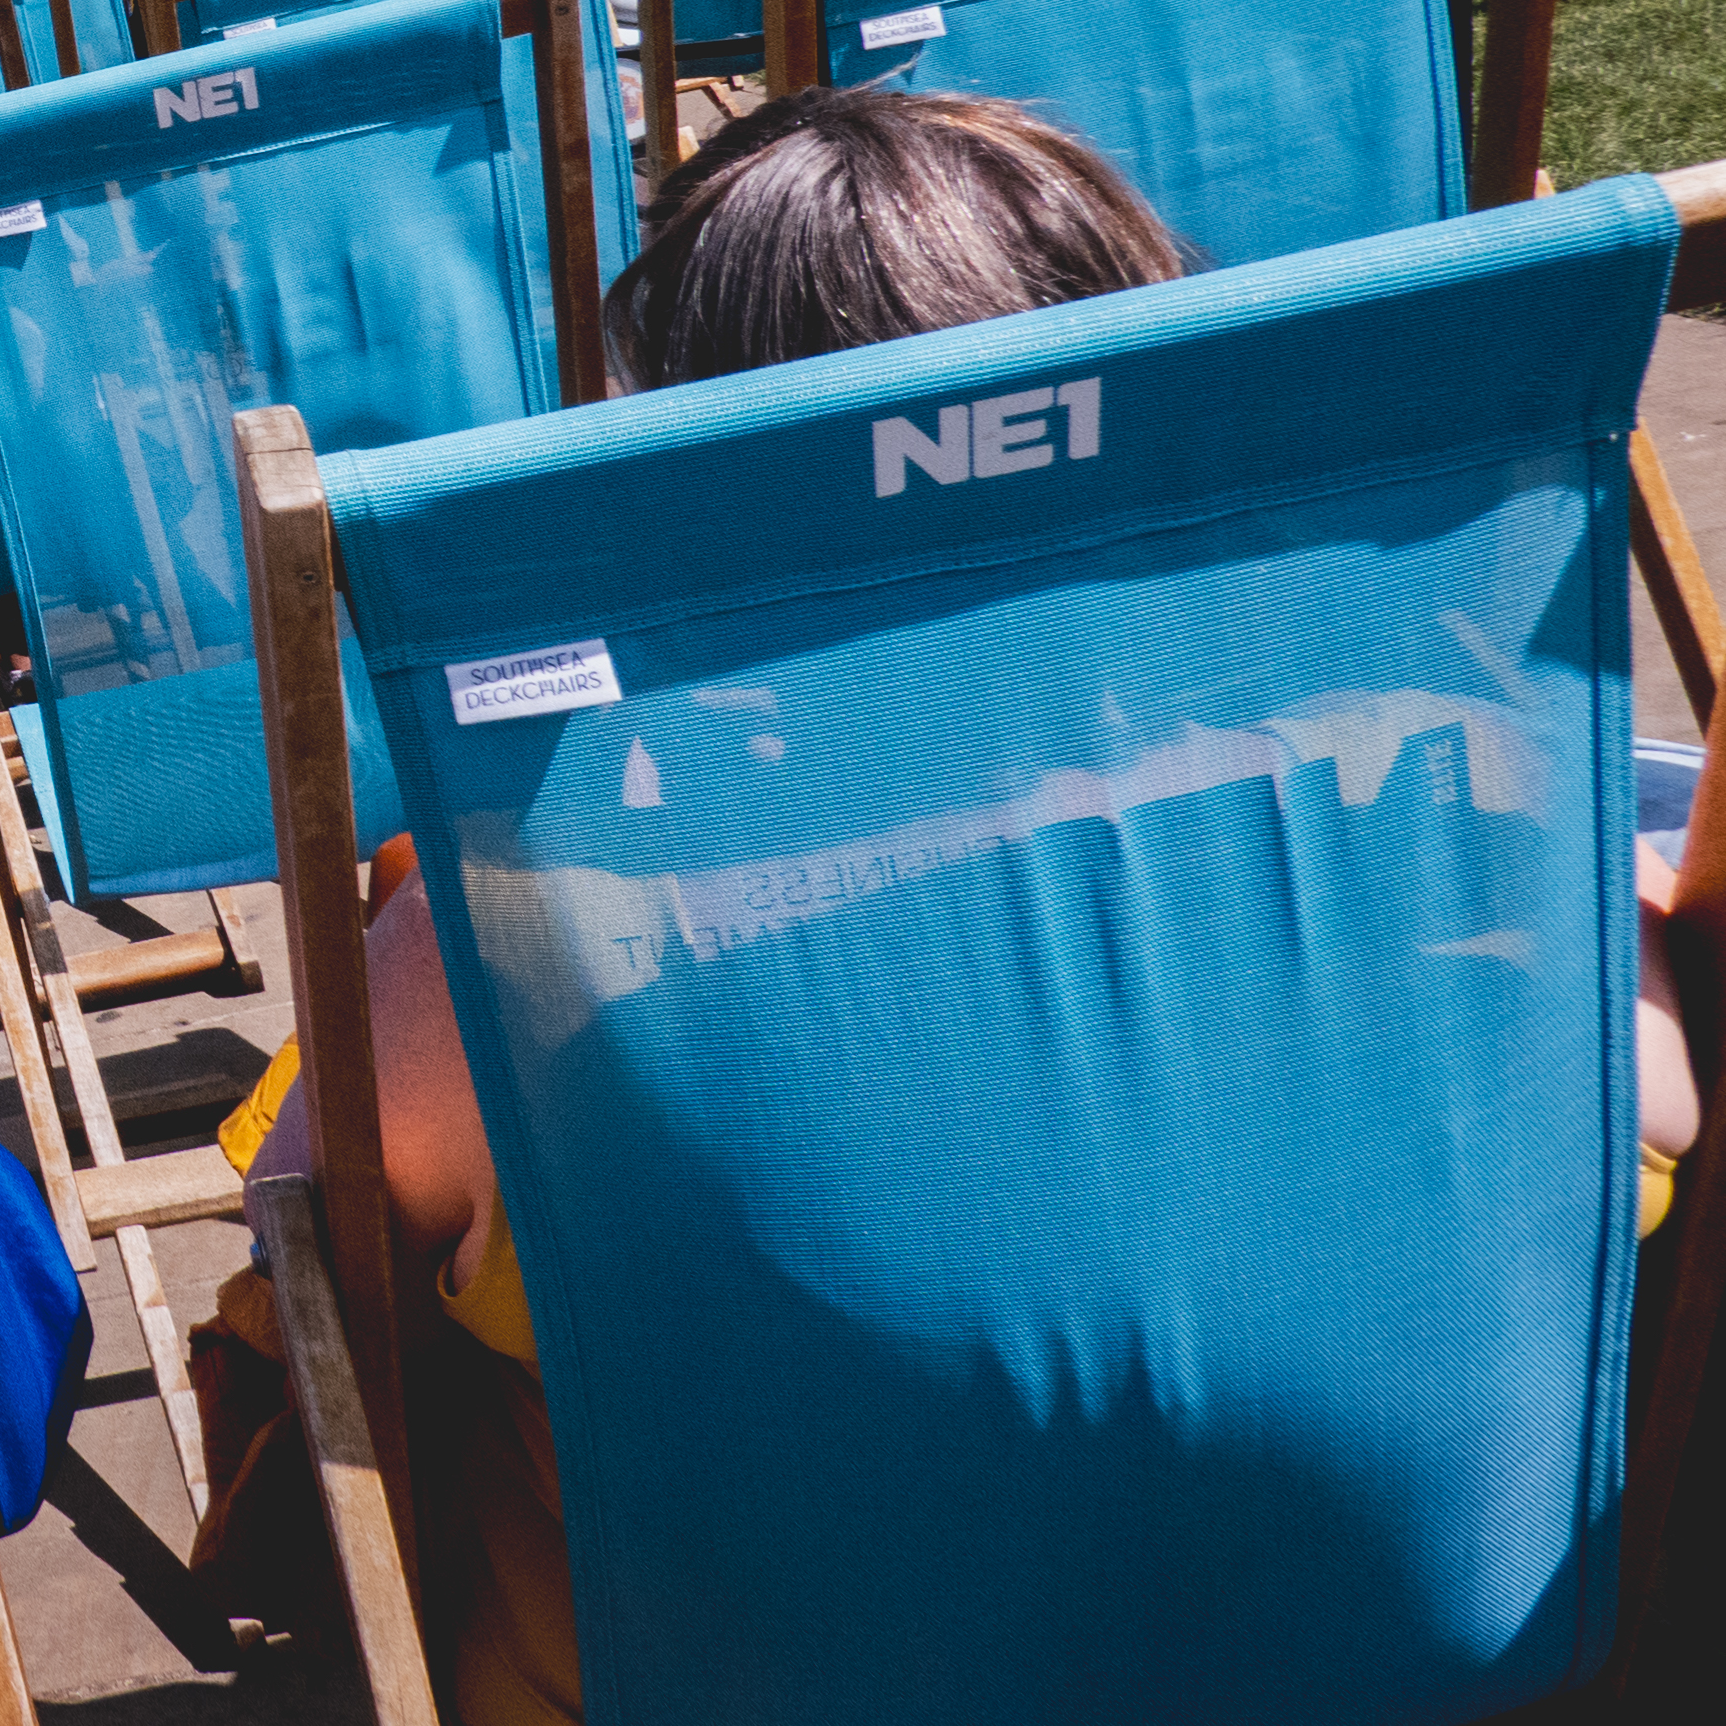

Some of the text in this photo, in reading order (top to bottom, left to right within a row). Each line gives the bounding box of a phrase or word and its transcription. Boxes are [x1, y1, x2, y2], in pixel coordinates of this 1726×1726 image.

[869, 22, 936, 42] DECKCHAIRS
[872, 12, 928, 30] SOUTHSEA
[153, 67, 259, 128] NE1
[873, 378, 1100, 497] NE1
[471, 650, 586, 685] SOUTHSEA
[465, 671, 602, 709] DECKCHAIRS
